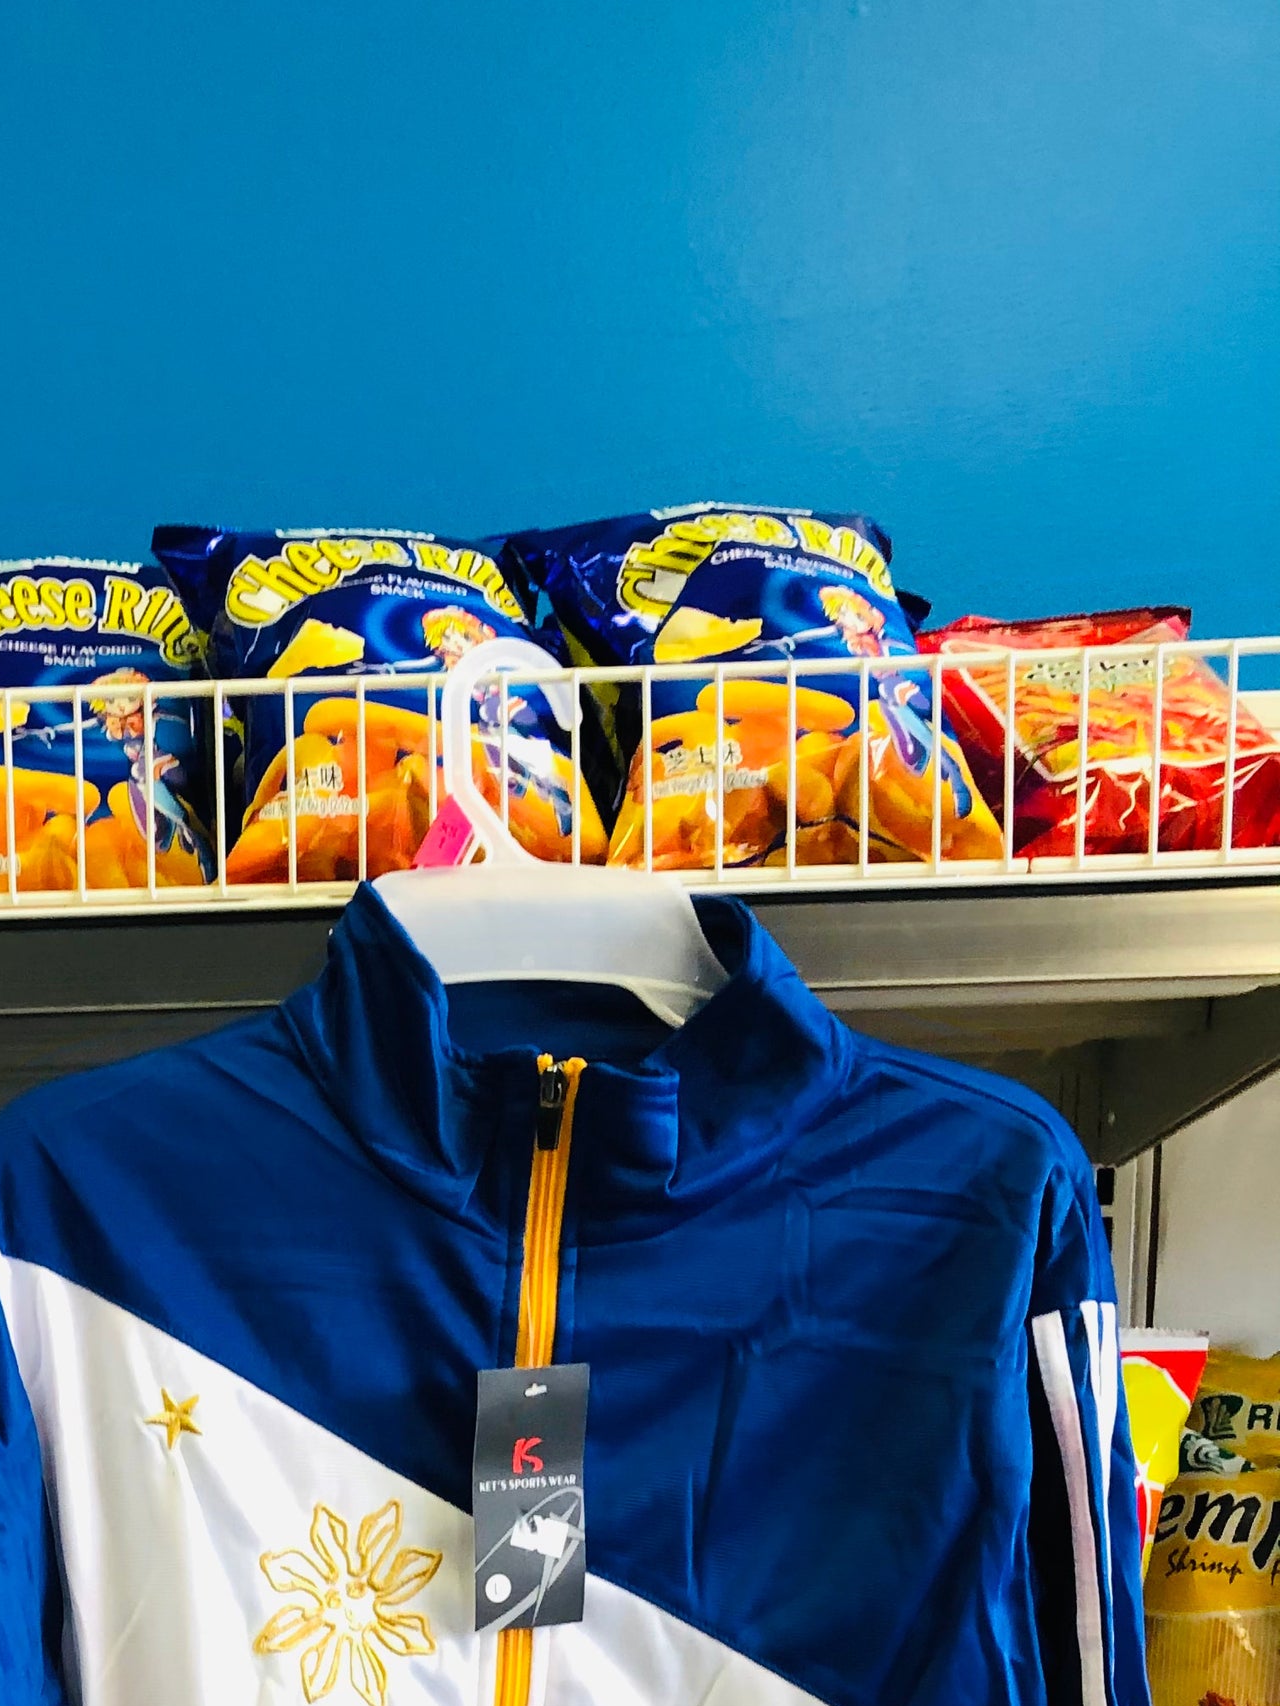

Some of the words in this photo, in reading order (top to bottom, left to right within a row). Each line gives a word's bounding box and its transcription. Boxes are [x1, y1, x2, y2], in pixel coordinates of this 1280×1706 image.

[43, 655, 97, 668] SNACK
[508, 1475, 547, 1490] SPORTS
[549, 1474, 577, 1487] WEAR
[1165, 1545, 1243, 1585] Shrimp
